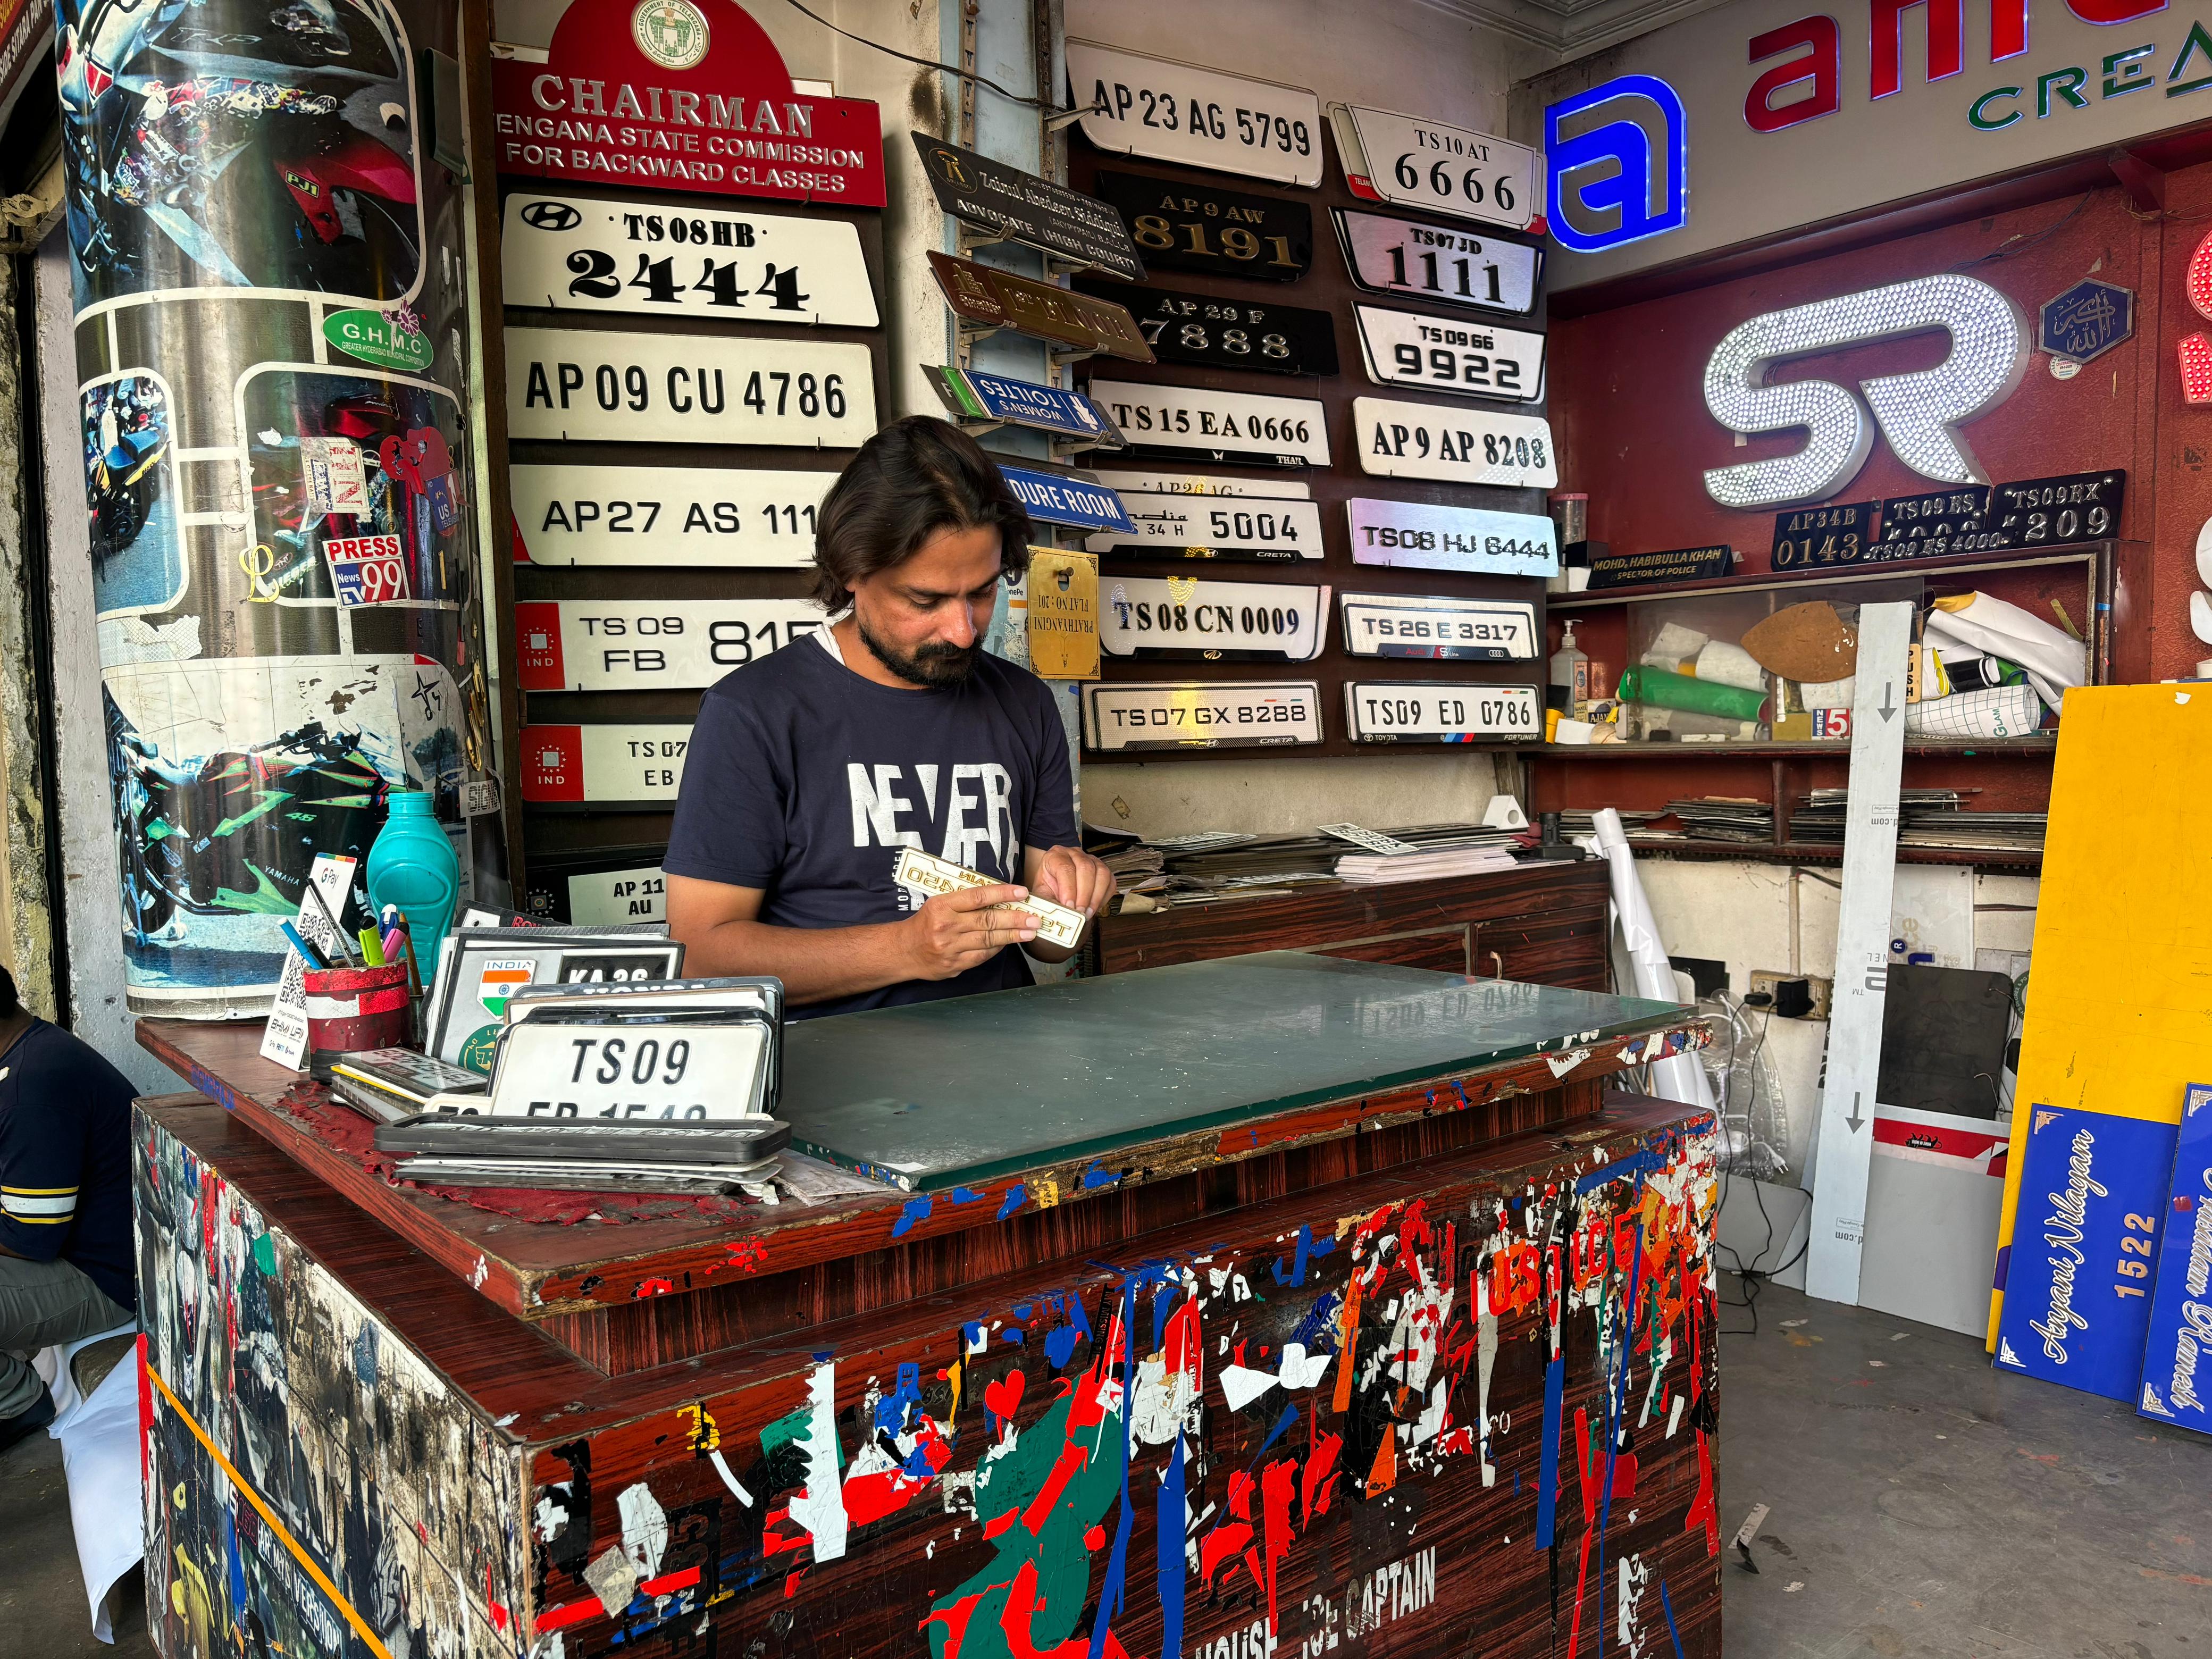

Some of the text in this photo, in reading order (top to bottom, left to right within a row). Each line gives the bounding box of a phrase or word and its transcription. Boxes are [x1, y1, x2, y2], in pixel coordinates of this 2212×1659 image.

[639, 1, 664, 26] GOVERNMENT
[679, 5, 701, 36] TELANGANA
[532, 74, 813, 138] CHAIRMAN
[1236, 107, 1311, 156] 5799
[621, 127, 699, 153] STATE
[708, 136, 864, 169] COMMISSION
[507, 143, 845, 193] FOR BACKWARD CLASSES
[1394, 153, 1515, 211] 6666
[288, 172, 319, 197] PJ1
[957, 198, 1036, 235] ADVOCATE
[1133, 214, 1302, 268] 8191
[566, 249, 810, 312] 2444
[1386, 245, 1506, 304] 1111
[342, 341, 362, 352] GREATER
[363, 345, 387, 357] HYDERABAD
[1139, 318, 1290, 359] 7888
[1394, 343, 1521, 390] 9922
[744, 371, 847, 420] 4786
[1704, 274, 2022, 509] SR
[1000, 399, 1065, 422] WOMEN'S
[1248, 415, 1310, 443] 0666
[1484, 433, 1547, 469] 8208
[438, 503, 450, 521] US
[541, 501, 661, 533] AP27
[683, 502, 741, 534] AS
[1067, 488, 1122, 520] ROOM
[1146, 524, 1184, 535] 34 H
[1210, 510, 1298, 541] 5004
[327, 536, 399, 562] PRESS
[1443, 533, 1477, 553] HJ
[1630, 554, 1688, 568] HABIBULLA
[1689, 548, 1722, 562] KHAN
[1775, 532, 1860, 568] 0143
[337, 573, 361, 584] News
[362, 562, 401, 602] 99
[1654, 568, 1666, 576] OF
[1667, 566, 1697, 574] POLICE
[1037, 594, 1050, 609] 201
[1069, 596, 1089, 612] FLAT
[1241, 607, 1300, 636] 0009
[1459, 623, 1518, 641] 3317
[526, 658, 554, 667] IND
[604, 650, 666, 672] FB
[1366, 699, 1531, 726] TS09 ED 0786
[1826, 709, 1847, 736] 5
[1992, 708, 2009, 738] GLAM
[538, 776, 565, 784] IND
[644, 769, 674, 786] EB
[848, 764, 1014, 856] NEVER
[265, 864, 301, 886] YAMAHA
[629, 900, 652, 915] AU
[487, 960, 533, 969] INDIA
[271, 1018, 288, 1034] BHIM
[571, 1038, 690, 1085] TS09
[2043, 1128, 2109, 1264] Nilayam
[2113, 1213, 2156, 1299] 1522
[1346, 1546, 1436, 1641] CAPTAIN
